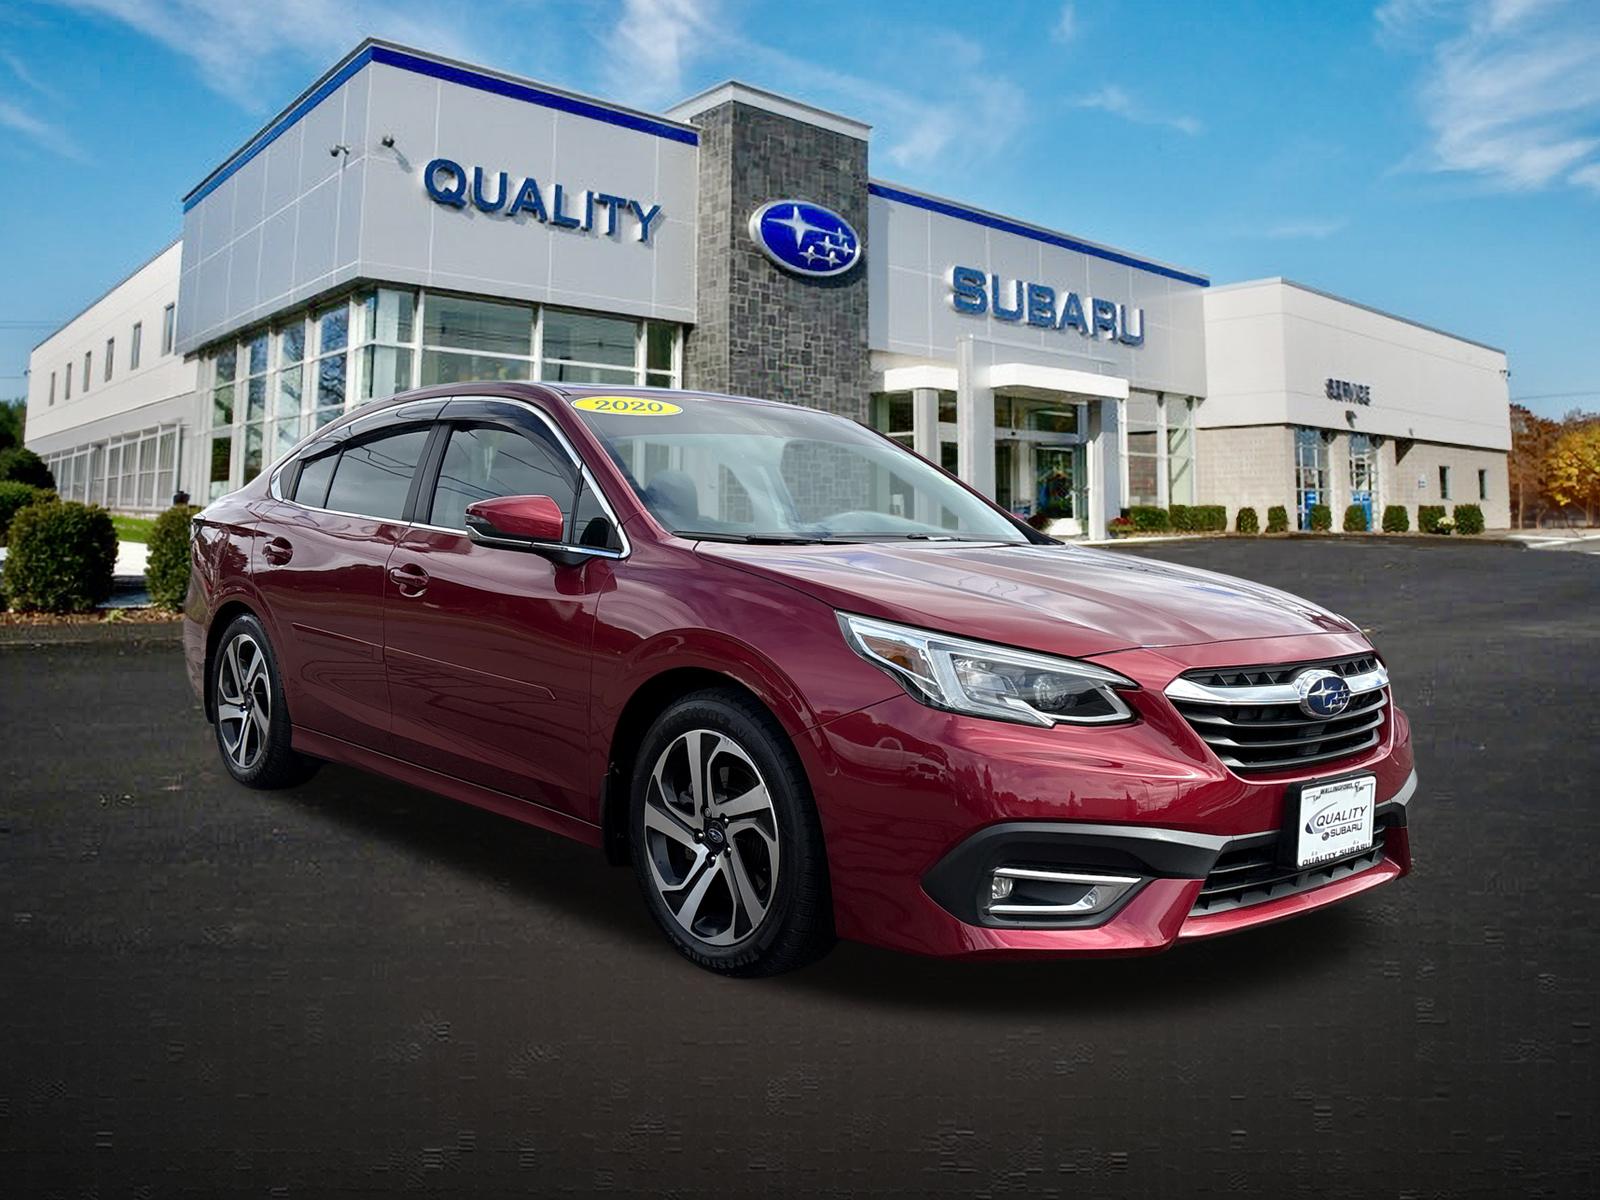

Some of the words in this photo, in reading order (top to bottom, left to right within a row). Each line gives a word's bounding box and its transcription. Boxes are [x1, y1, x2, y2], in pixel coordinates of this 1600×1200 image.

[424, 158, 661, 242] QUALITY
[949, 265, 1145, 347] SUBARU
[1325, 378, 1371, 406] SERVICE
[594, 400, 663, 412] 2020
[1316, 805, 1367, 827] QUALITY
[1330, 822, 1363, 837] SUBARU
[1302, 851, 1337, 866] QUALITY
[1339, 842, 1371, 856] SUBARU
